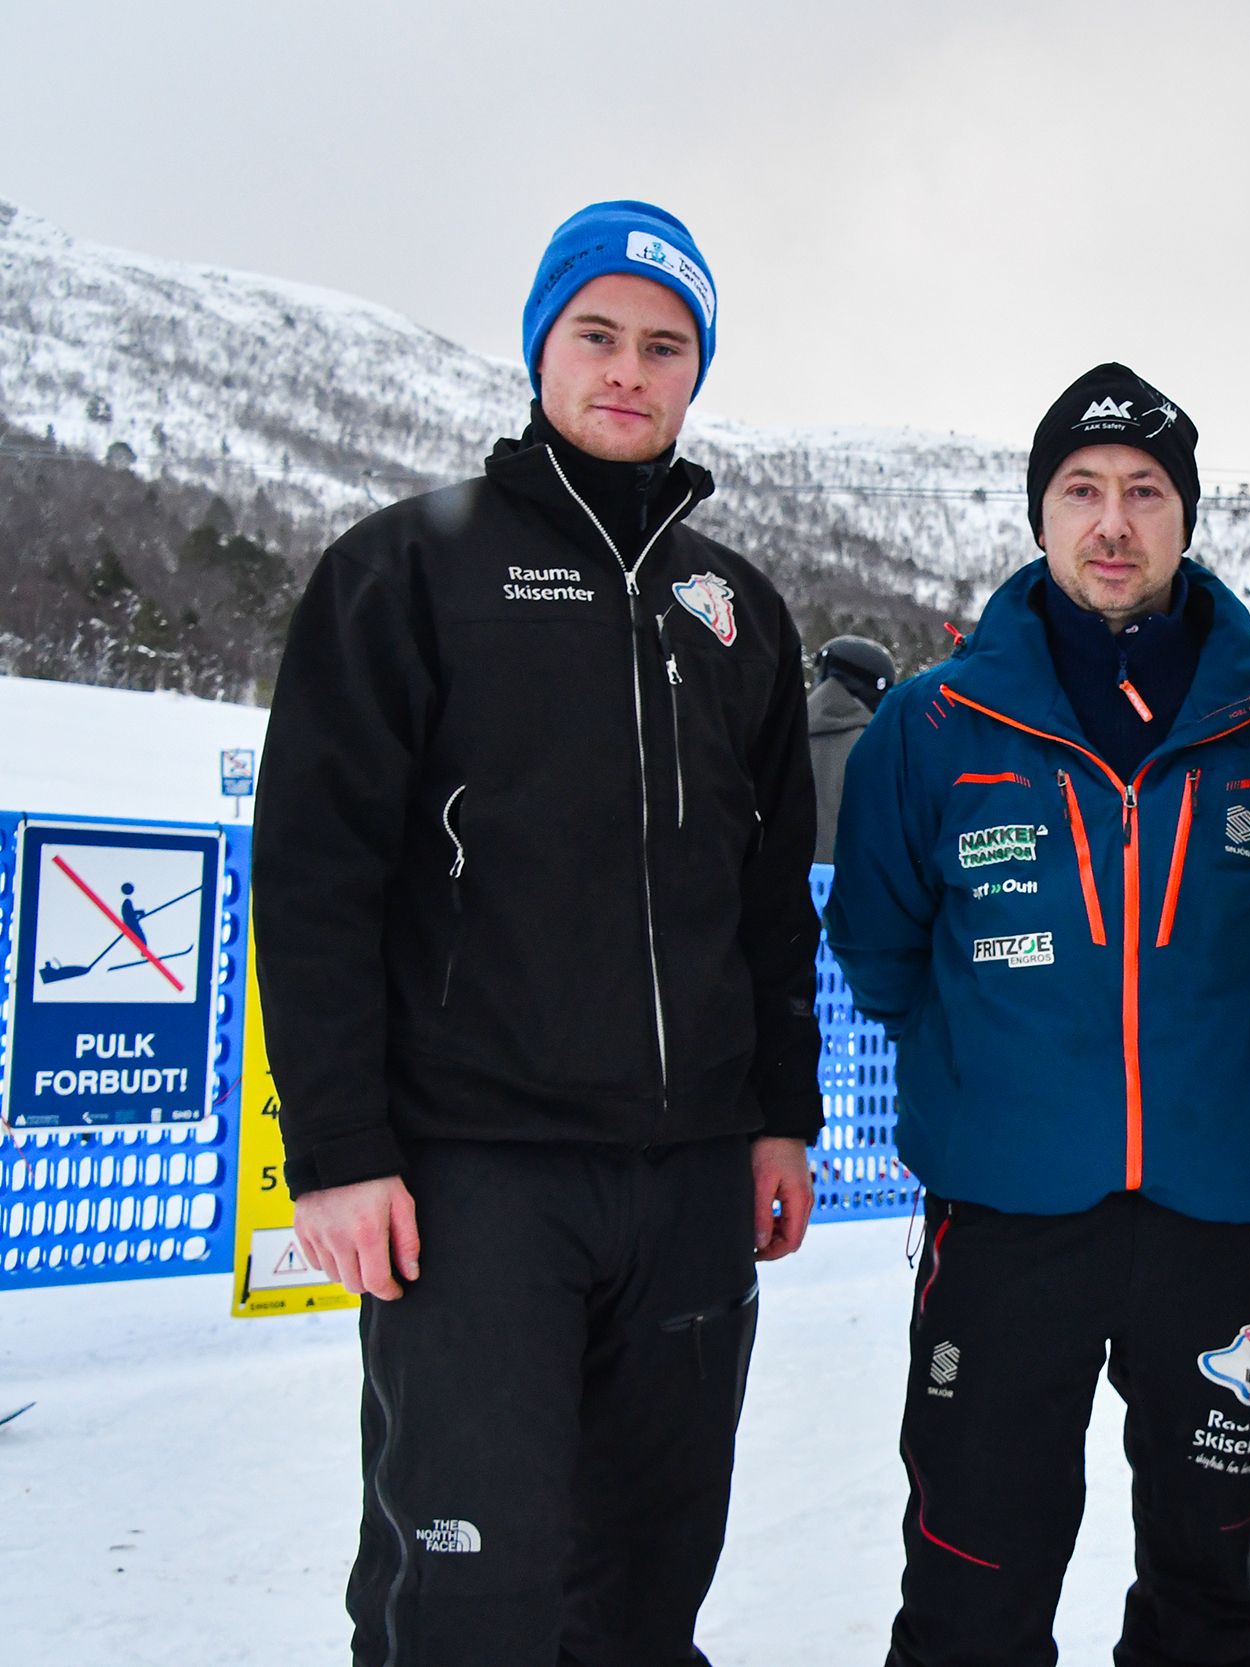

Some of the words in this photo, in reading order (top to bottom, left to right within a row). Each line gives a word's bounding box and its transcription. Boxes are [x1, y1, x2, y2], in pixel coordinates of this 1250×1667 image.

[508, 566, 581, 582] Rauma
[503, 584, 595, 602] Skisenter
[975, 935, 1050, 959] FRITZOE
[1010, 954, 1052, 965] ENGROS
[75, 1033, 156, 1059] PULK
[34, 1068, 189, 1096] FORBUDT!
[261, 1096, 279, 1119] 4
[261, 1167, 277, 1190] 5
[433, 1519, 458, 1530] THE
[416, 1529, 457, 1541] NORTH
[426, 1541, 456, 1552] FACE
